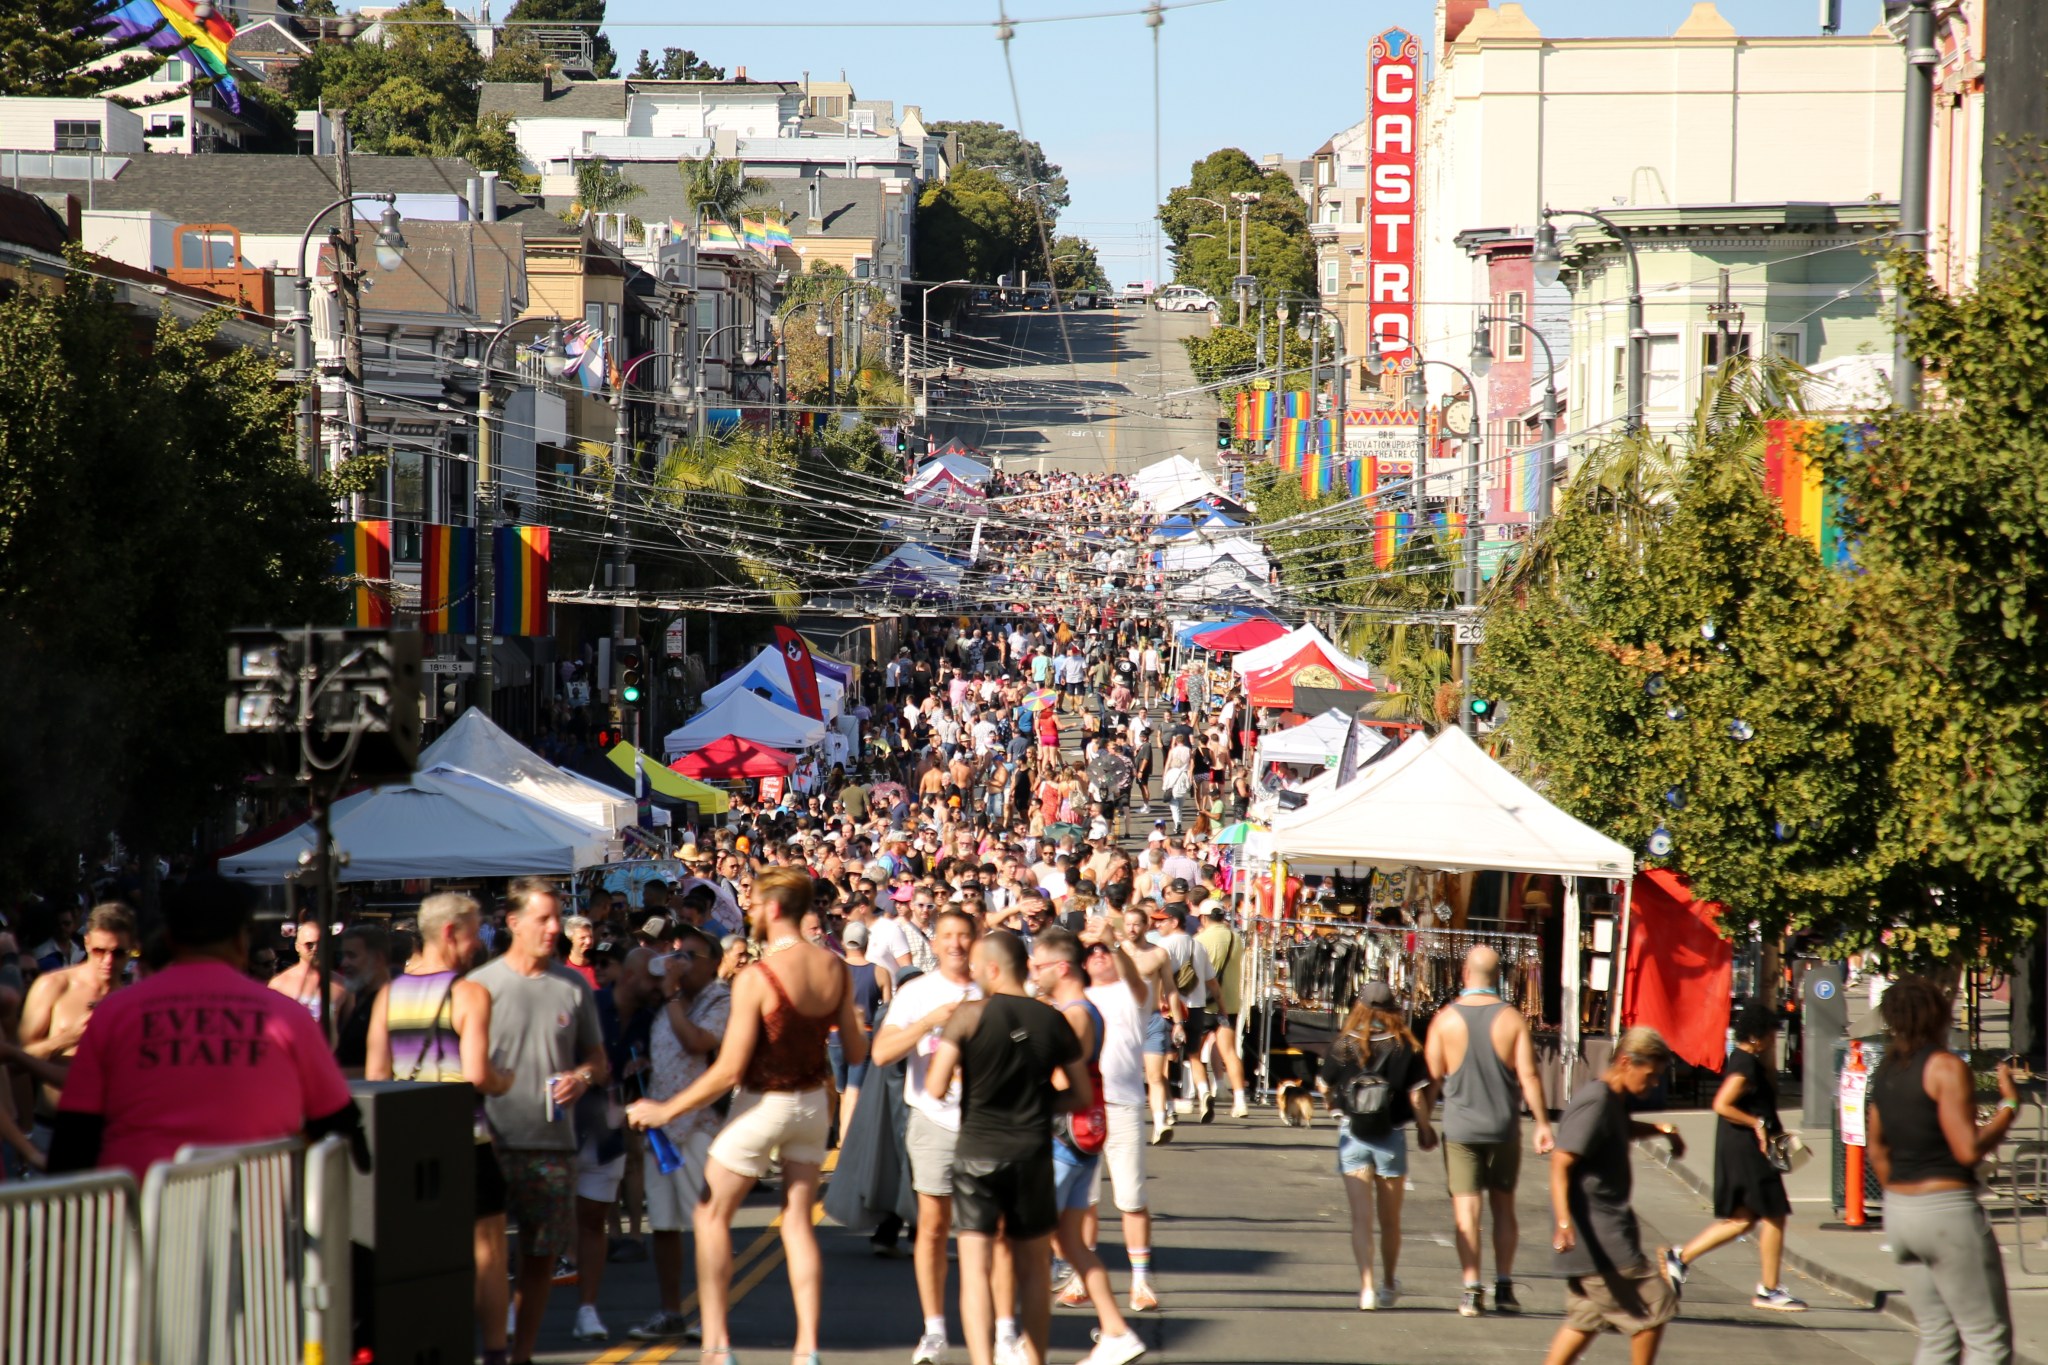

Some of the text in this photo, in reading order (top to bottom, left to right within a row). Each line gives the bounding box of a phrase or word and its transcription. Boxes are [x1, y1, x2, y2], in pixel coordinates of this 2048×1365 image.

[1373, 64, 1414, 352] CASTRO
[1460, 625, 1482, 639] 20
[142, 1008, 271, 1039] EVENT
[138, 1039, 270, 1069] STAFF
